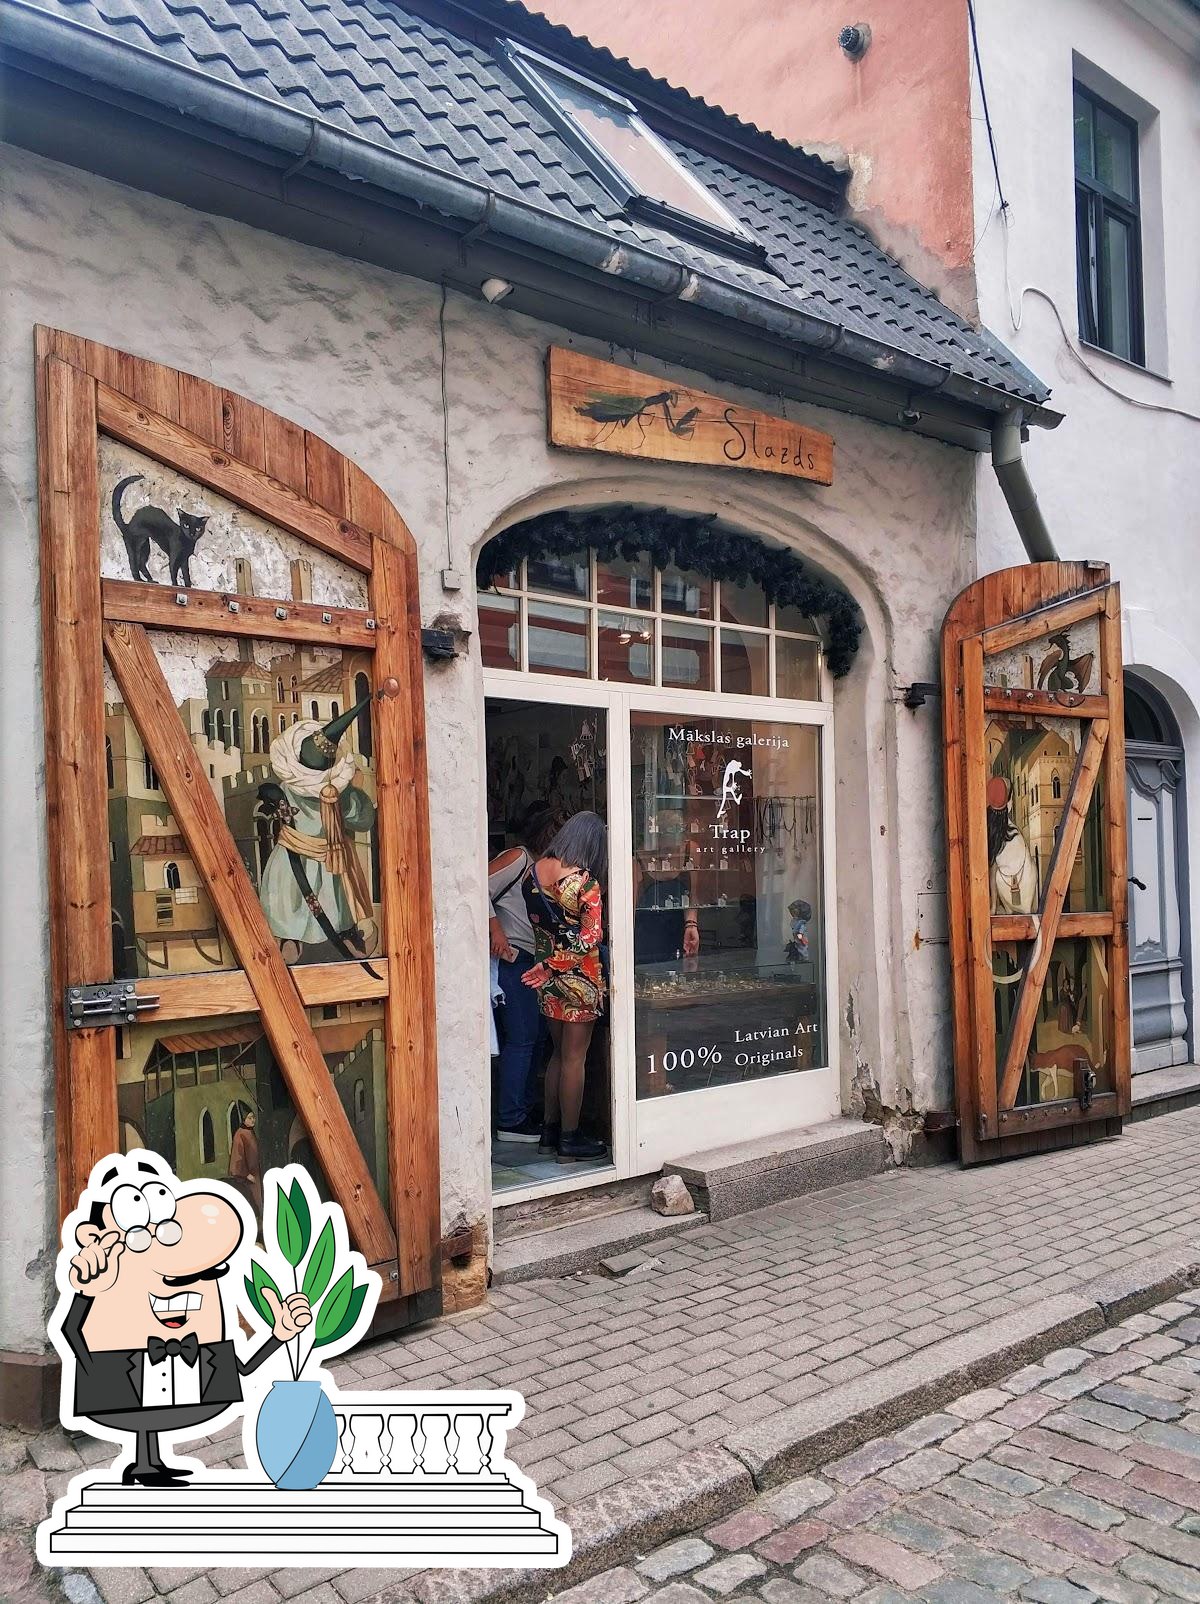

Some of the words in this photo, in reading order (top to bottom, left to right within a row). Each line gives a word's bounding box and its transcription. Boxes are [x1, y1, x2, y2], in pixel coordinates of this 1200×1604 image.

[723, 408, 815, 470] Slazds
[668, 727, 731, 744] Mākslas
[736, 734, 790, 749] galerija
[709, 824, 751, 843] Trap
[721, 845, 766, 854] gallery
[734, 1026, 790, 1043] Latvian
[794, 1022, 818, 1035] Art
[647, 1044, 722, 1074] 100%
[735, 1045, 804, 1067] Originals
